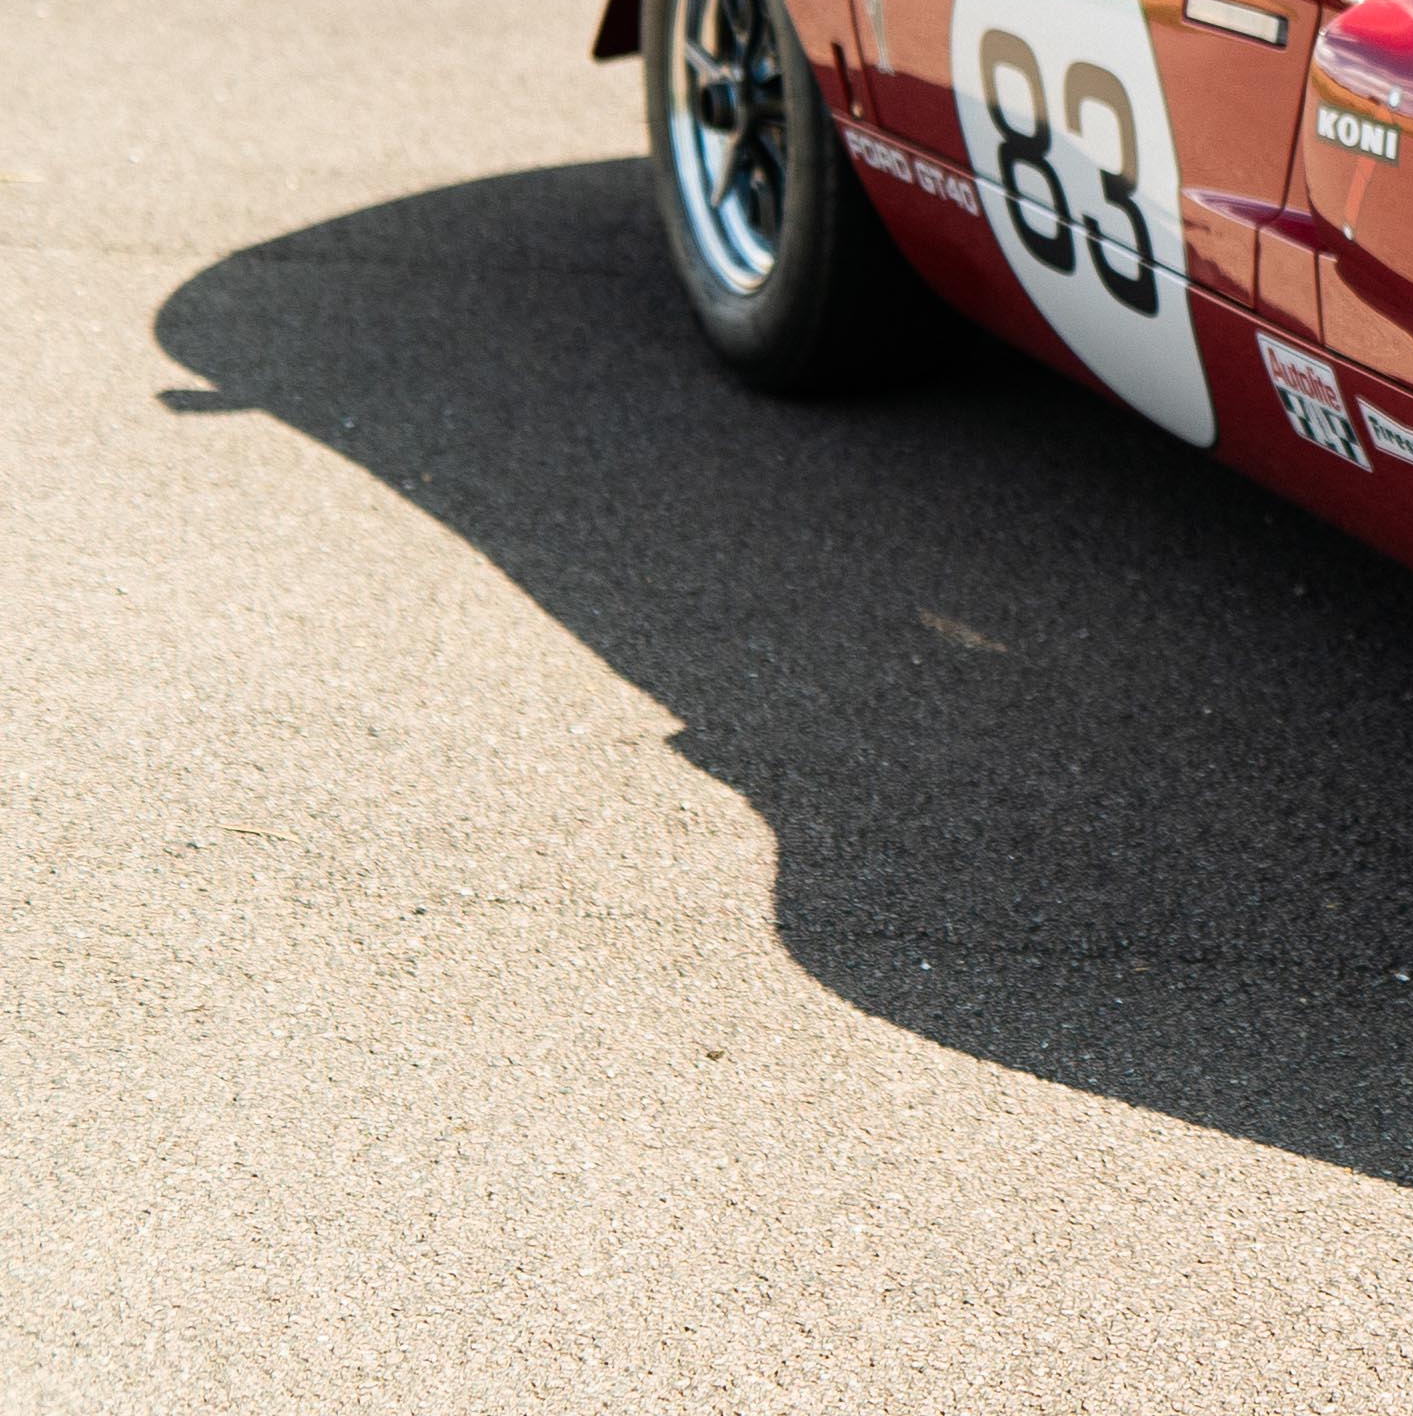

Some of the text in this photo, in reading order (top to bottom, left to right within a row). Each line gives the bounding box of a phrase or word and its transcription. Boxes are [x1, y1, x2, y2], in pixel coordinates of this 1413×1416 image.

[1316, 108, 1397, 161] KONI
[844, 129, 979, 217] FORD GT40
[978, 28, 1159, 318] 83
[1267, 347, 1342, 412] Autolite
